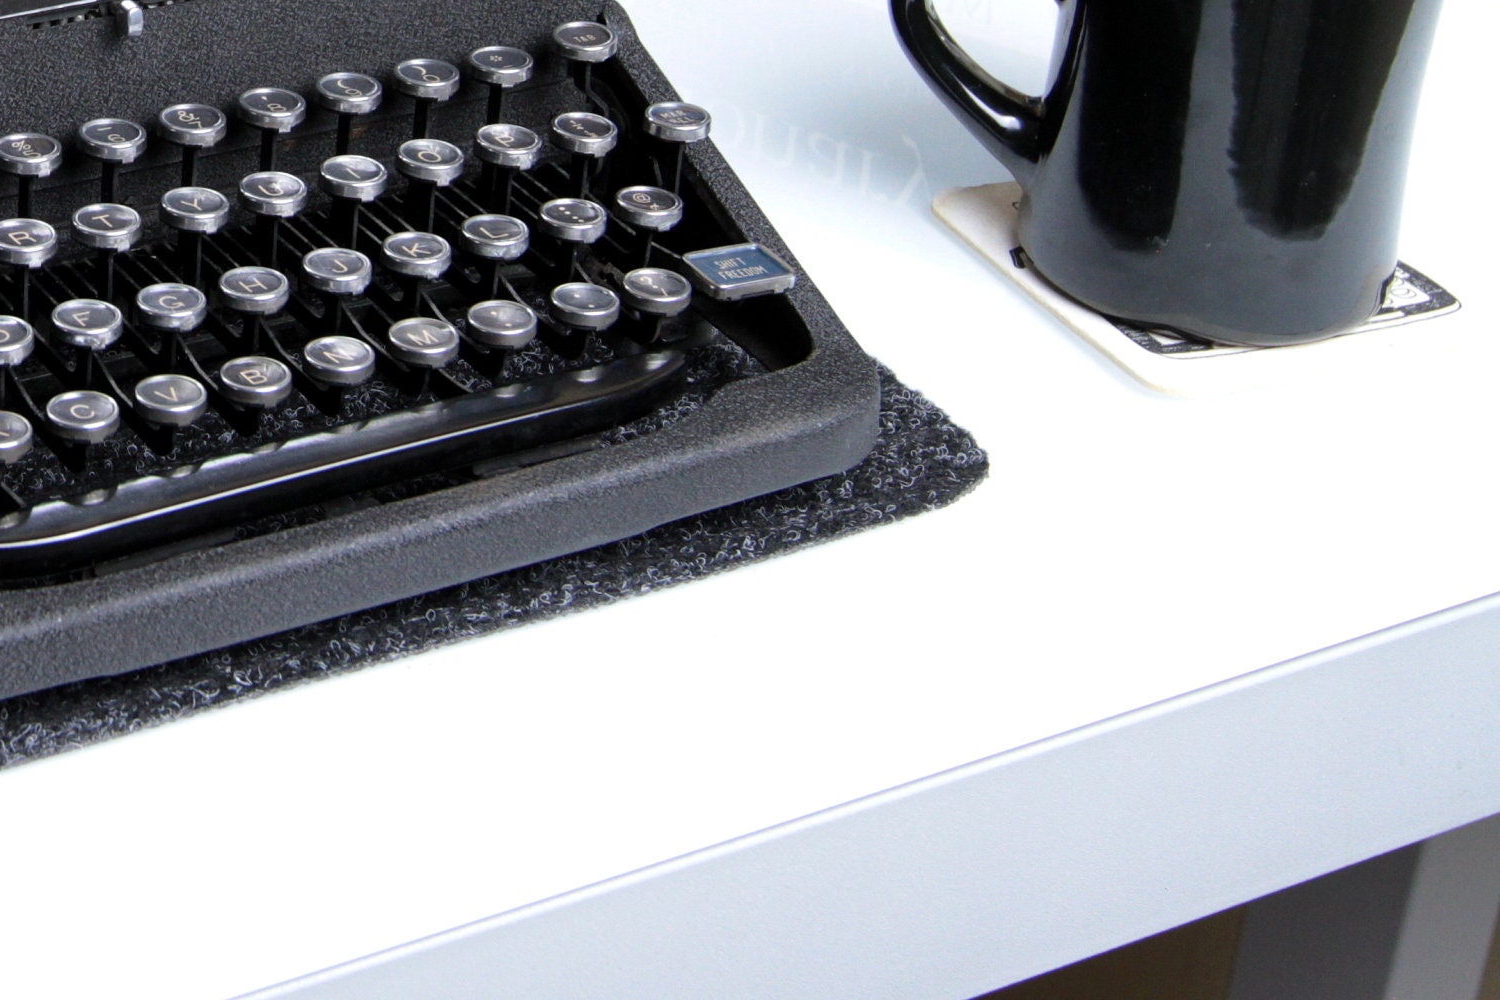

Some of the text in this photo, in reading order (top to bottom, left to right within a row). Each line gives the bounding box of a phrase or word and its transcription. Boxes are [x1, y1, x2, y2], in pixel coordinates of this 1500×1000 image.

[573, 33, 597, 43] TAB
[493, 134, 515, 148] P
[258, 182, 285, 197] U
[180, 197, 203, 212] Y
[91, 213, 114, 228] T
[7, 230, 37, 247] R
[478, 226, 509, 240] L
[402, 241, 431, 258] K
[331, 258, 349, 273] J
[714, 257, 746, 269] SHIFT
[718, 265, 769, 280] FREEDOM
[238, 277, 268, 293] H
[158, 295, 185, 311] G
[72, 310, 92, 327] F
[406, 329, 438, 347] M
[323, 349, 356, 364] N
[239, 368, 268, 385] B
[154, 386, 178, 402] V
[69, 404, 95, 420] C
